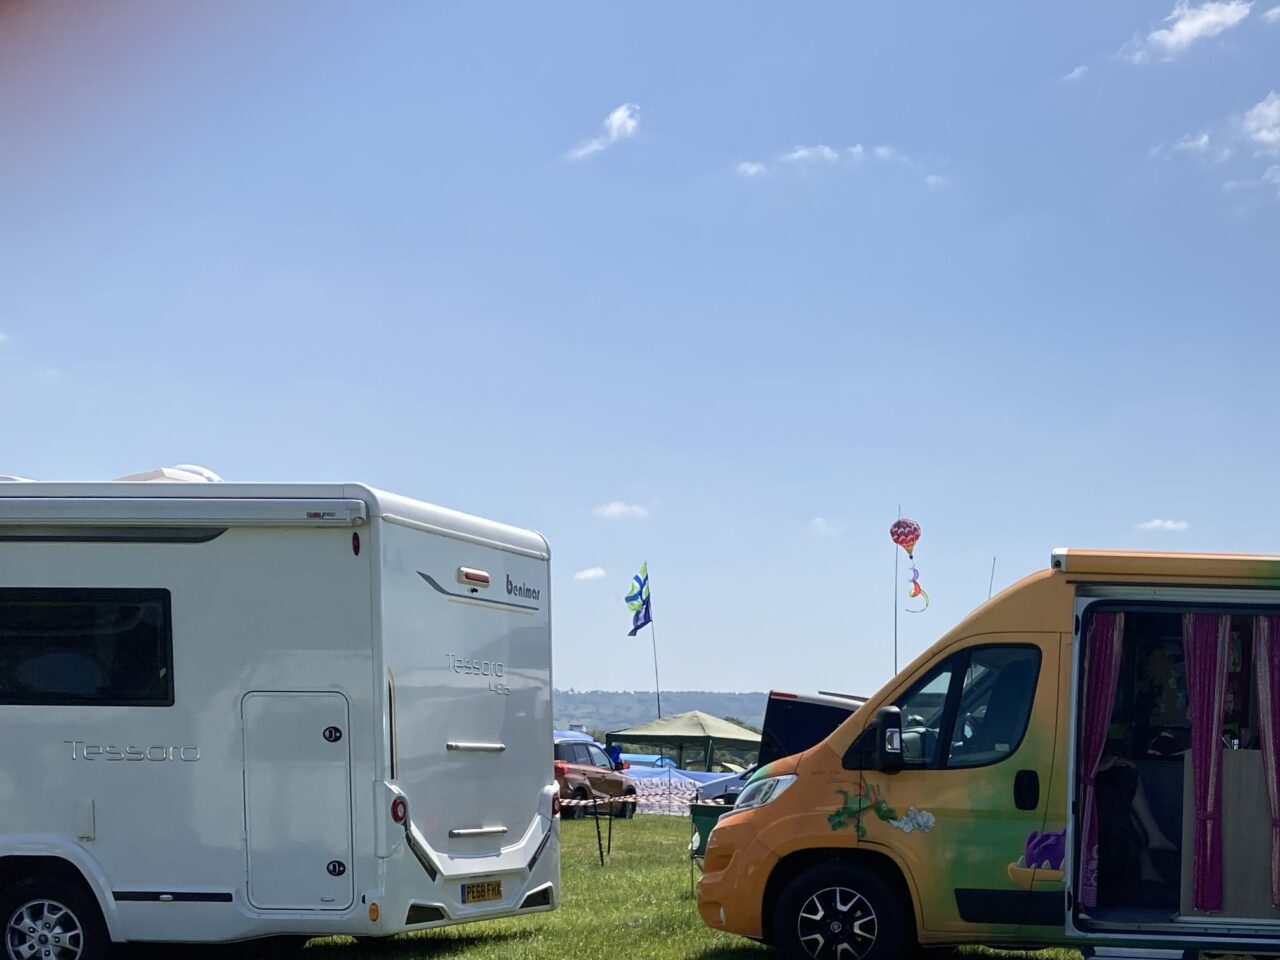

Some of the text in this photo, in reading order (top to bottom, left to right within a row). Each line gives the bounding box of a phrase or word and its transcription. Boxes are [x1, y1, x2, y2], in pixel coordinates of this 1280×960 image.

[506, 574, 540, 600] benimar
[445, 653, 504, 677] Tessoro
[63, 740, 201, 762] Tessoro
